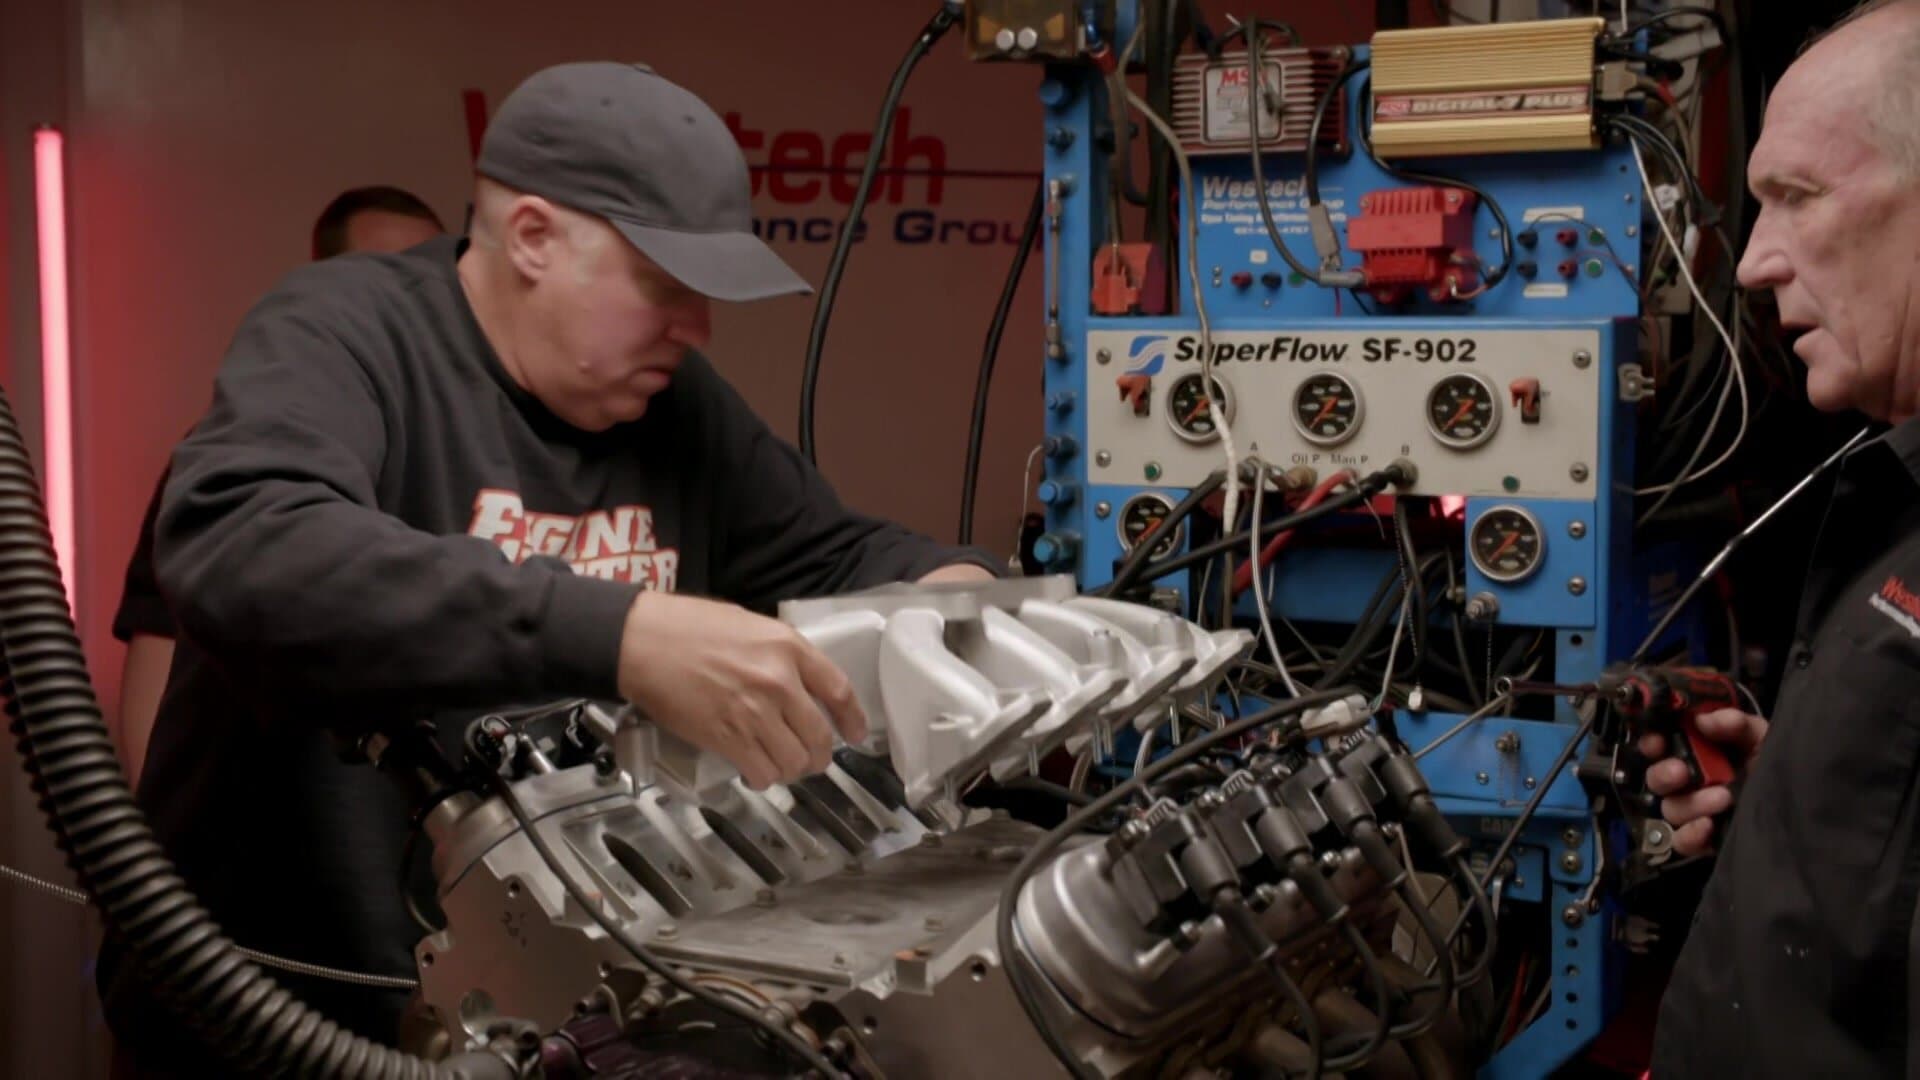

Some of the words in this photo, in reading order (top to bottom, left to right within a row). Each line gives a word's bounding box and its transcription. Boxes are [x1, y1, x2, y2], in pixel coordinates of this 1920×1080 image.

[894, 209, 1044, 254] Grou
[1174, 336, 1348, 366] SuperFlow
[1362, 337, 1477, 363] SF-902
